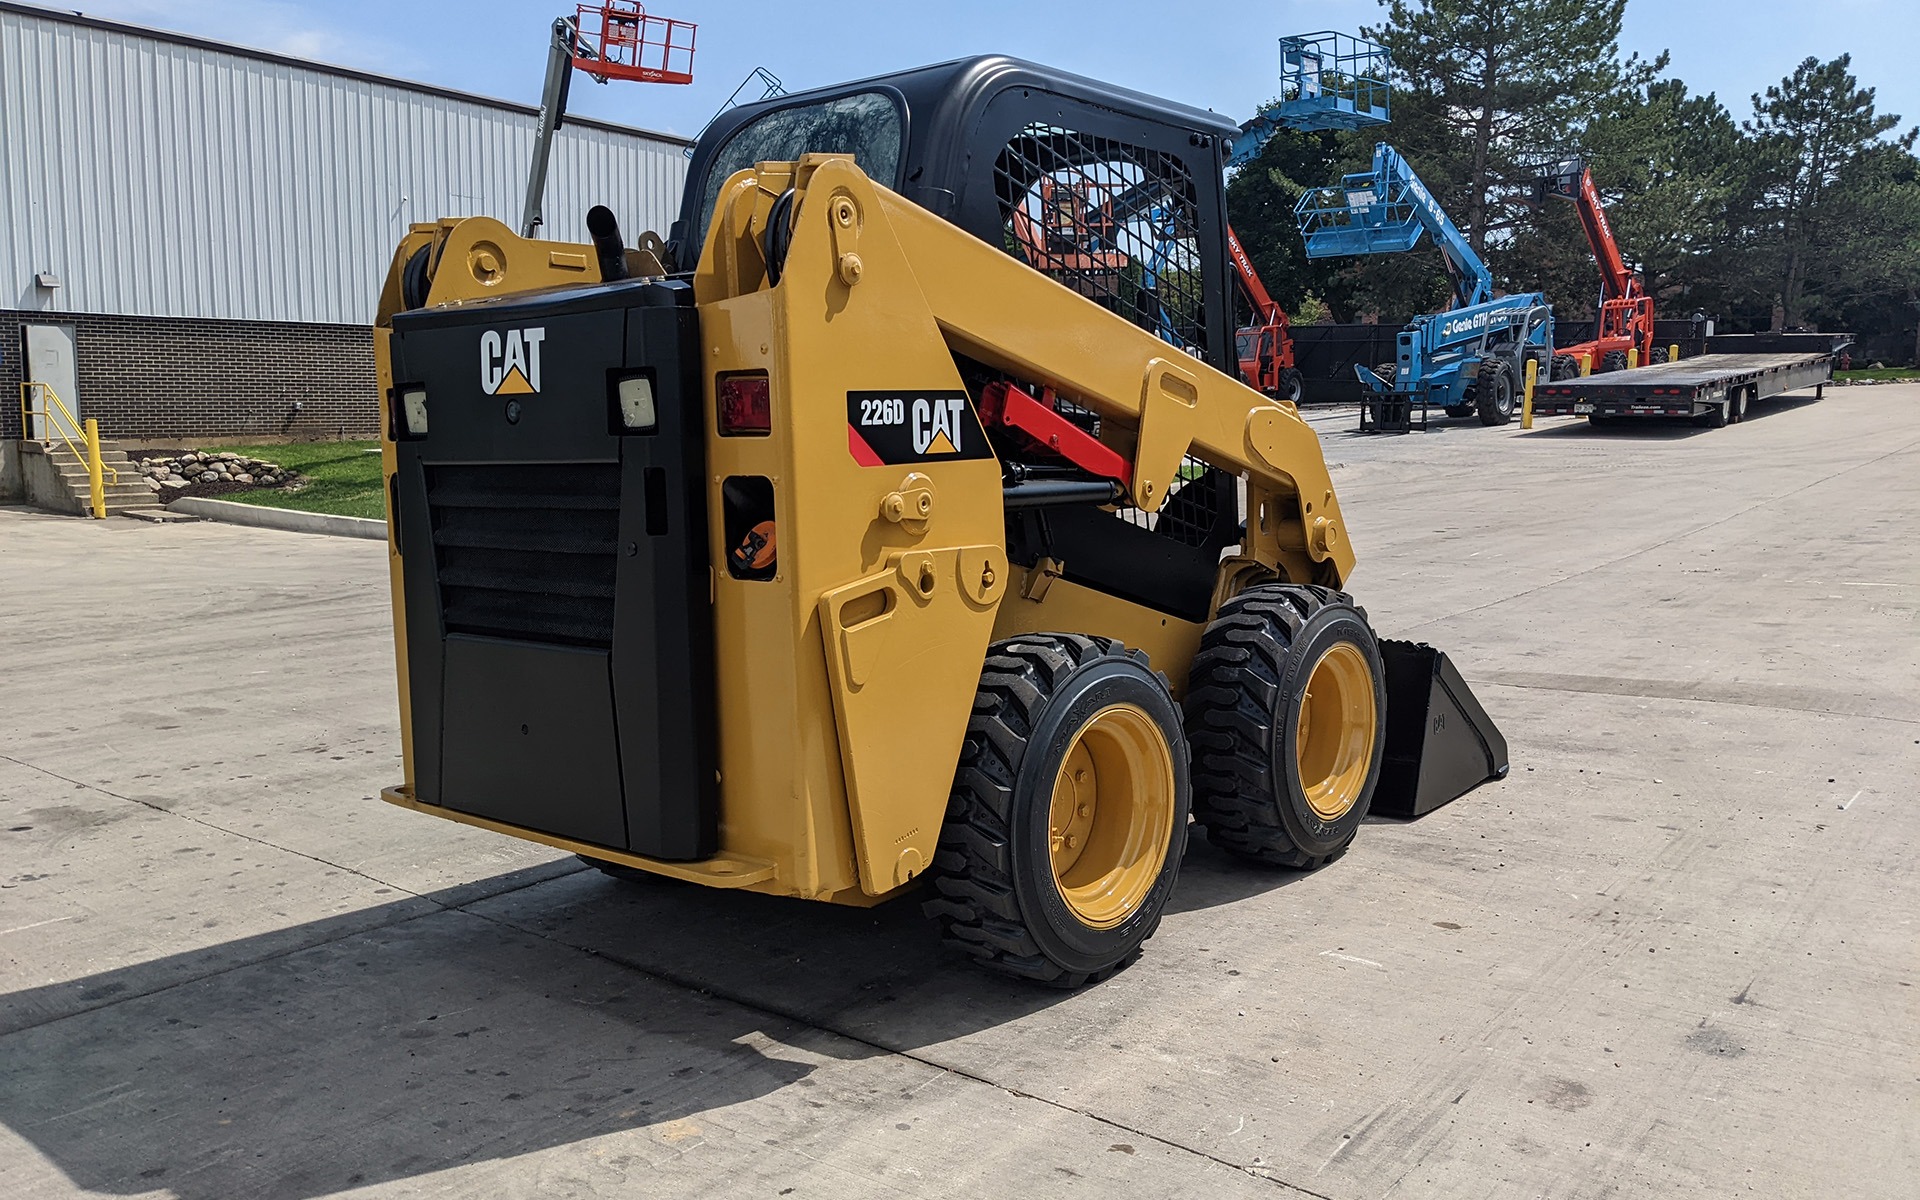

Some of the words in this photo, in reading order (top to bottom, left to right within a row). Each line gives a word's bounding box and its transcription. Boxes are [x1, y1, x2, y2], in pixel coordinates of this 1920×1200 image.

[1599, 211, 1610, 239] TRAK
[1228, 236, 1241, 254] SKY
[1239, 253, 1253, 277] TRAK
[1452, 318, 1473, 334] Genie
[480, 327, 545, 395] CAT
[860, 398, 905, 426] 226D
[912, 398, 964, 455] CAT
